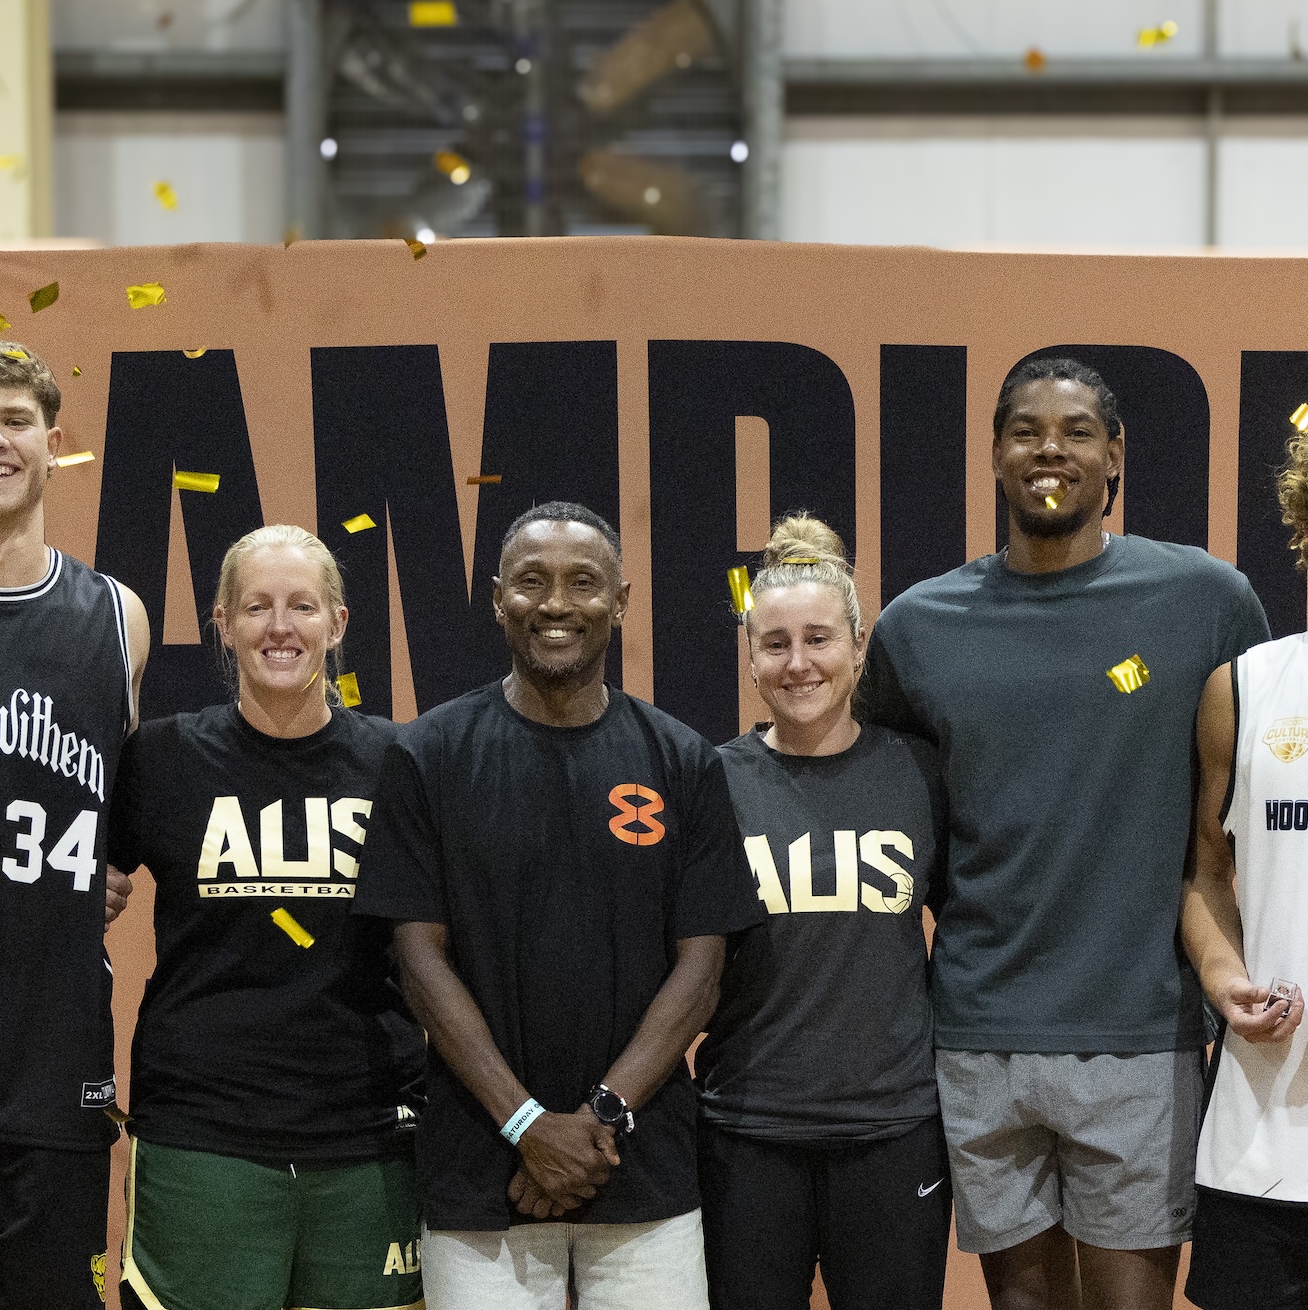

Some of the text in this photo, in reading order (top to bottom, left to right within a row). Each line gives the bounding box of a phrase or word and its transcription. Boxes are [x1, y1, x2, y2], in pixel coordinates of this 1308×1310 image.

[2, 799, 98, 892] 34
[197, 795, 373, 879] AUS
[742, 829, 915, 915] AUS
[206, 884, 352, 896] BASKETBA
[383, 1239, 422, 1276] AU
